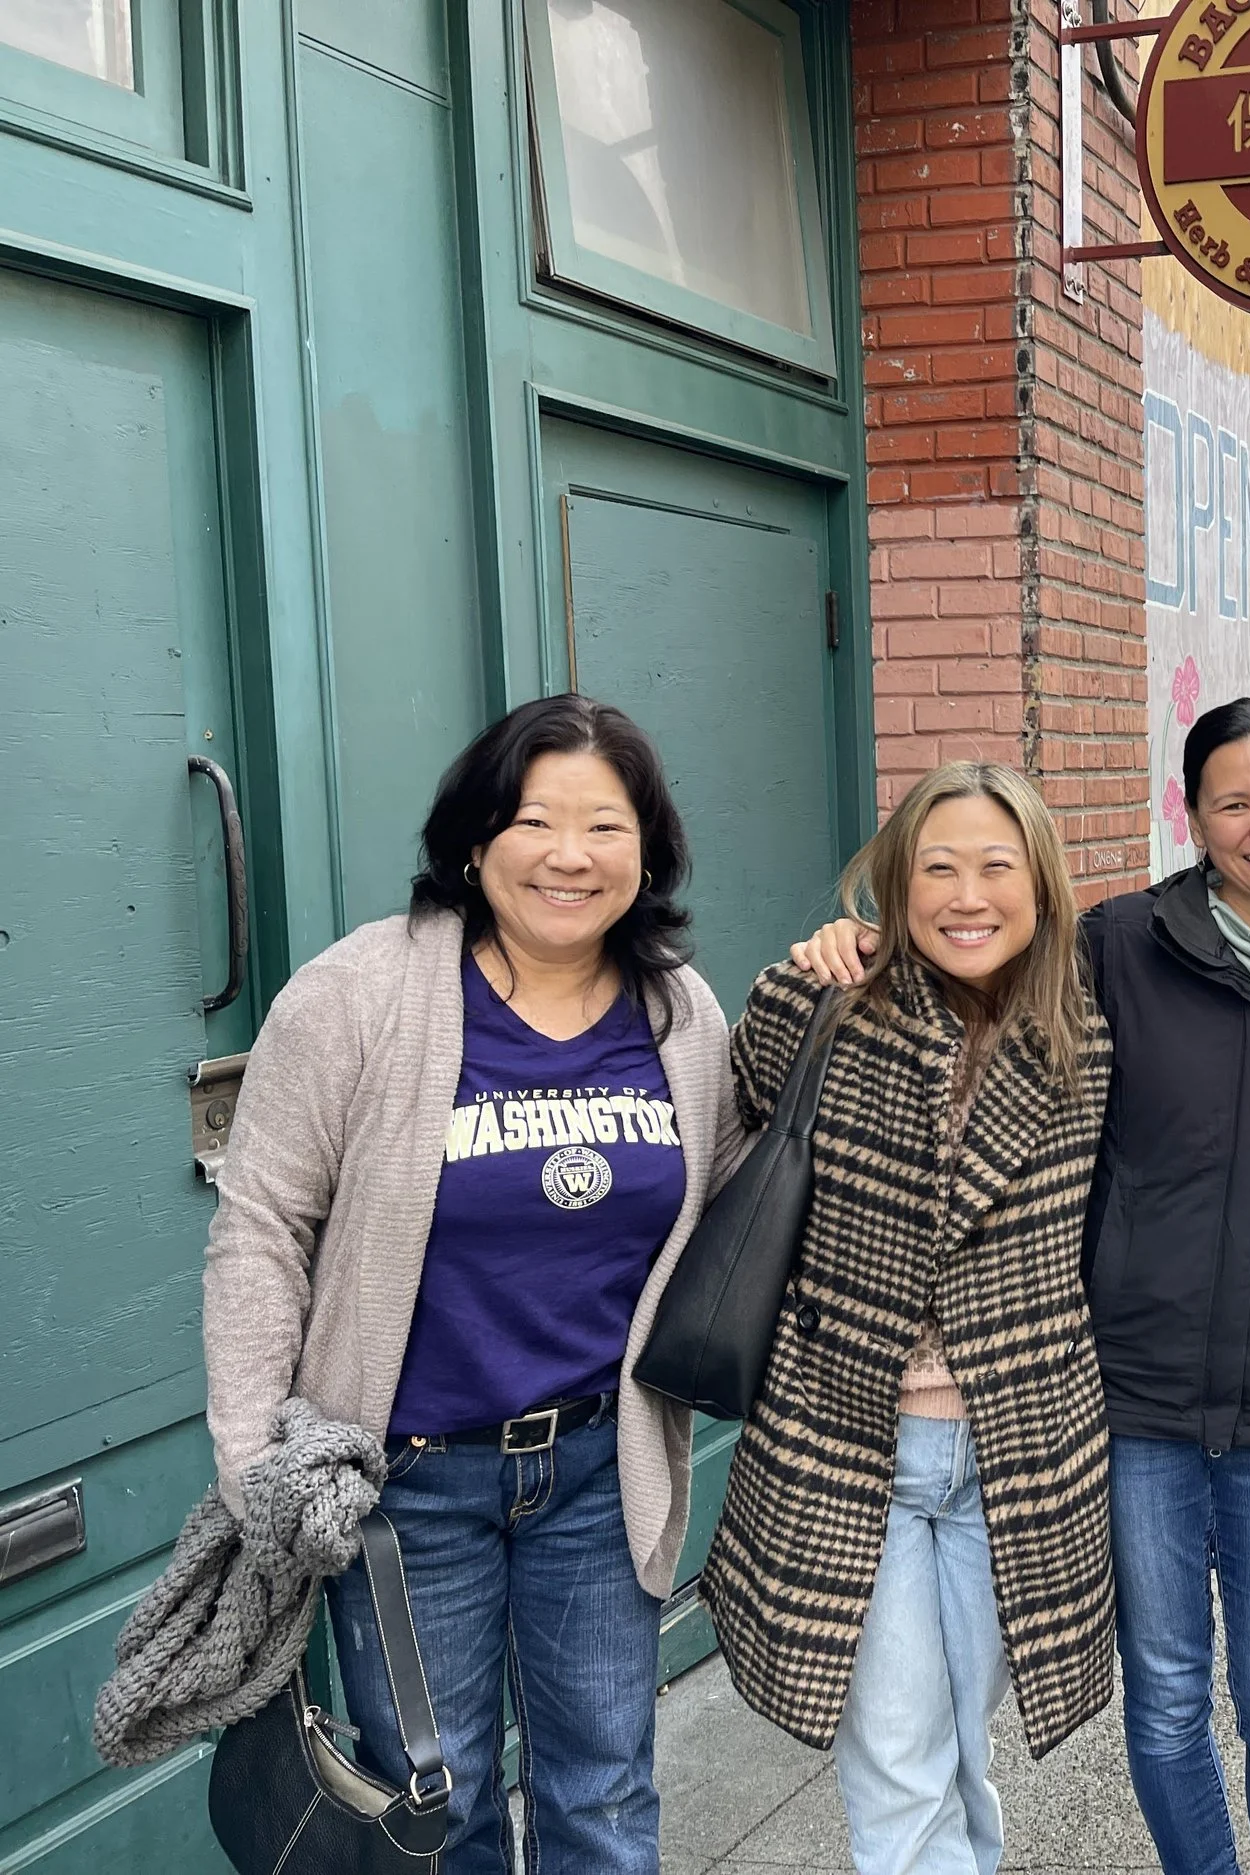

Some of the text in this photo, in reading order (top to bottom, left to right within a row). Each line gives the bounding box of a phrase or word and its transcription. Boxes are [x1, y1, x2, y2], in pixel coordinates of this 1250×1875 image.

[1173, 198, 1231, 269] Herb
[475, 1086, 648, 1103] UNIVERSITY OF
[444, 1095, 681, 1162] WASHINGTON
[563, 1172, 592, 1193] W
